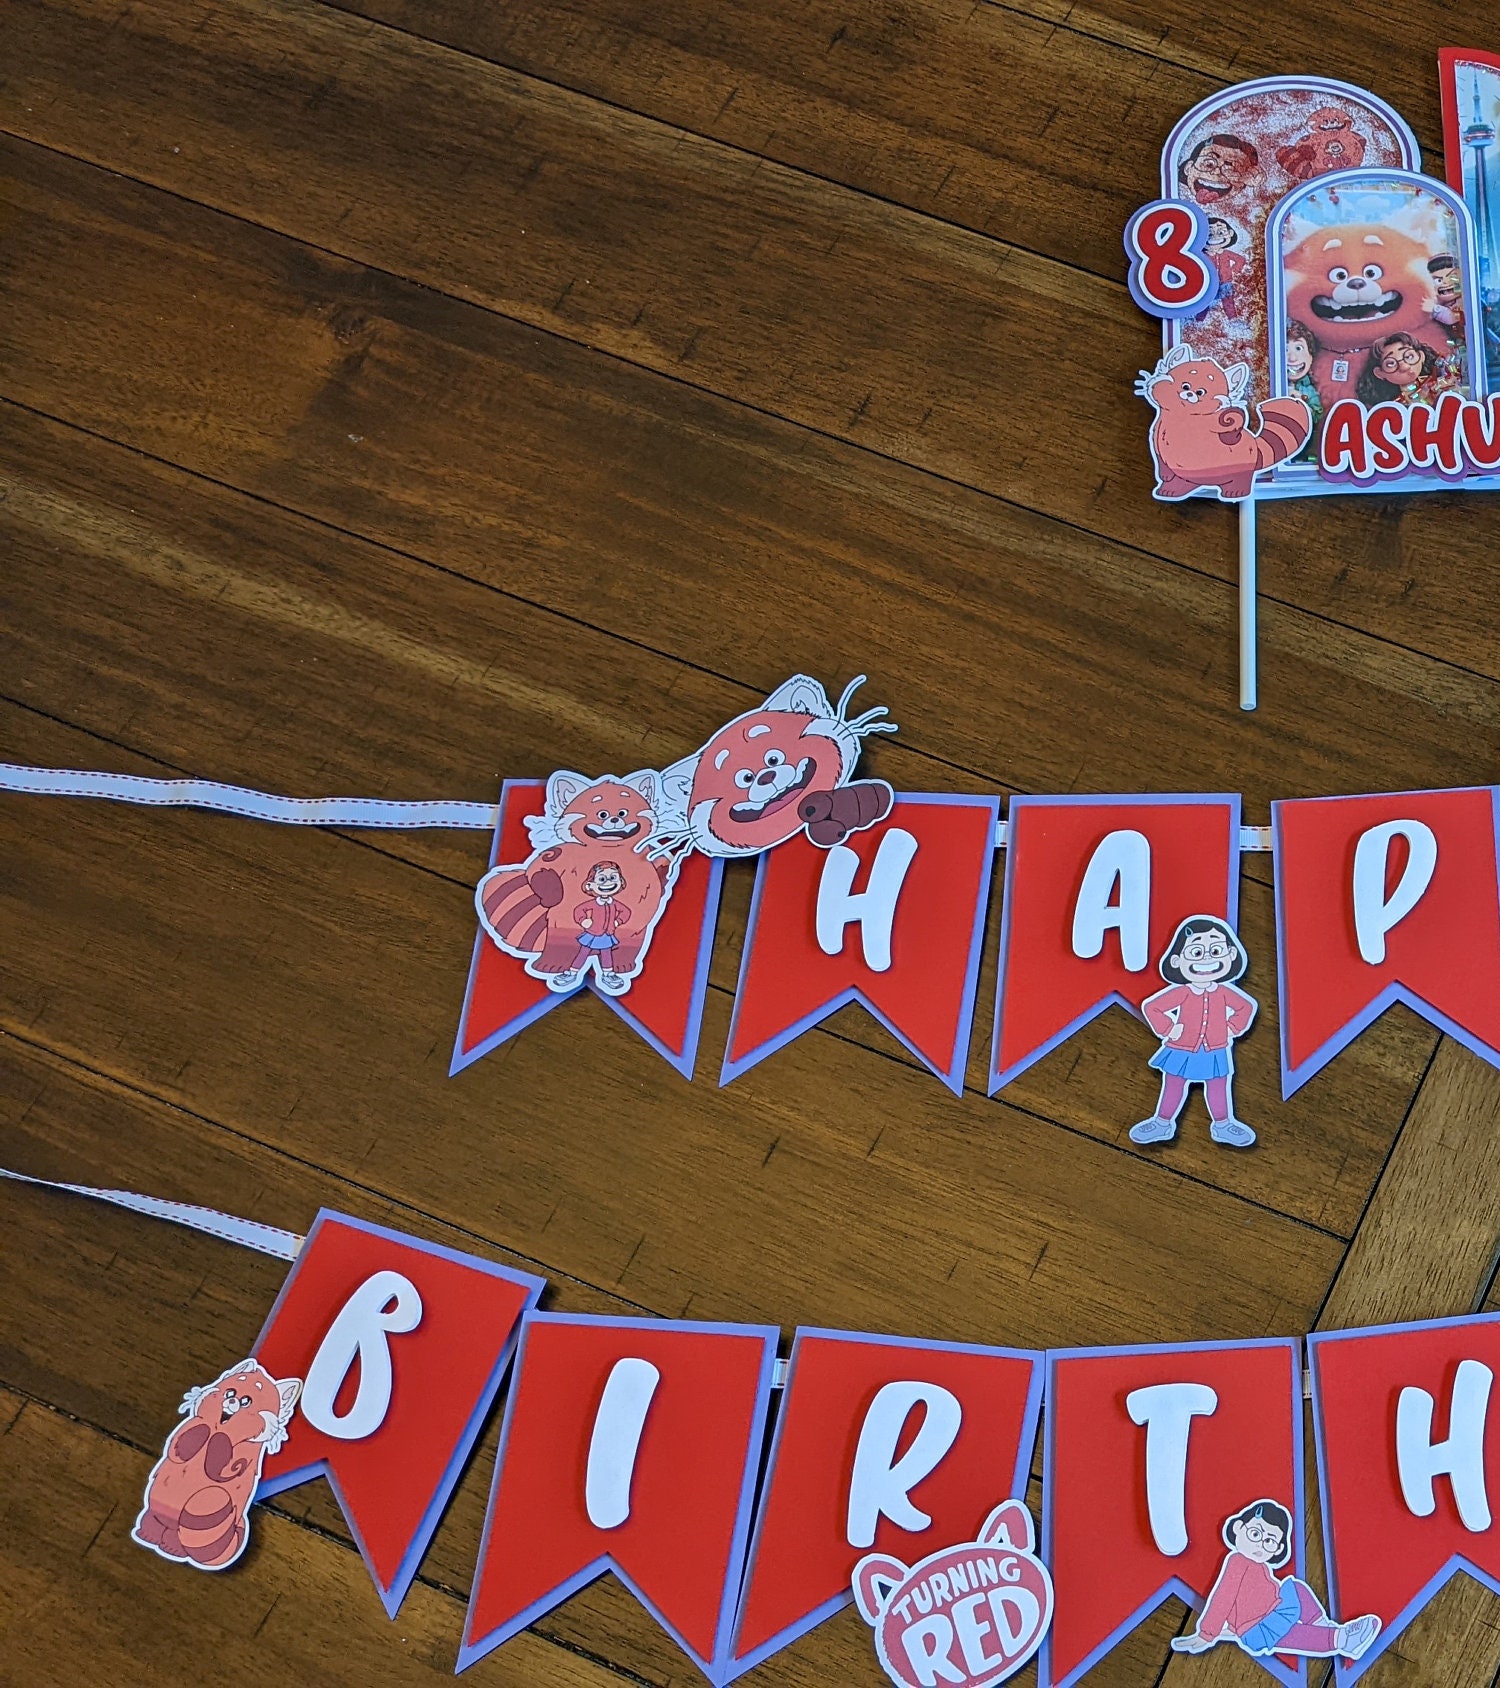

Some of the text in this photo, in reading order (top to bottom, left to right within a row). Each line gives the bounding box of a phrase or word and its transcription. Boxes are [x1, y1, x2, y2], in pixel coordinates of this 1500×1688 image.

[1132, 203, 1208, 307] 8
[892, 1557, 1021, 1625] TURNING
[901, 1586, 1040, 1687] RED
